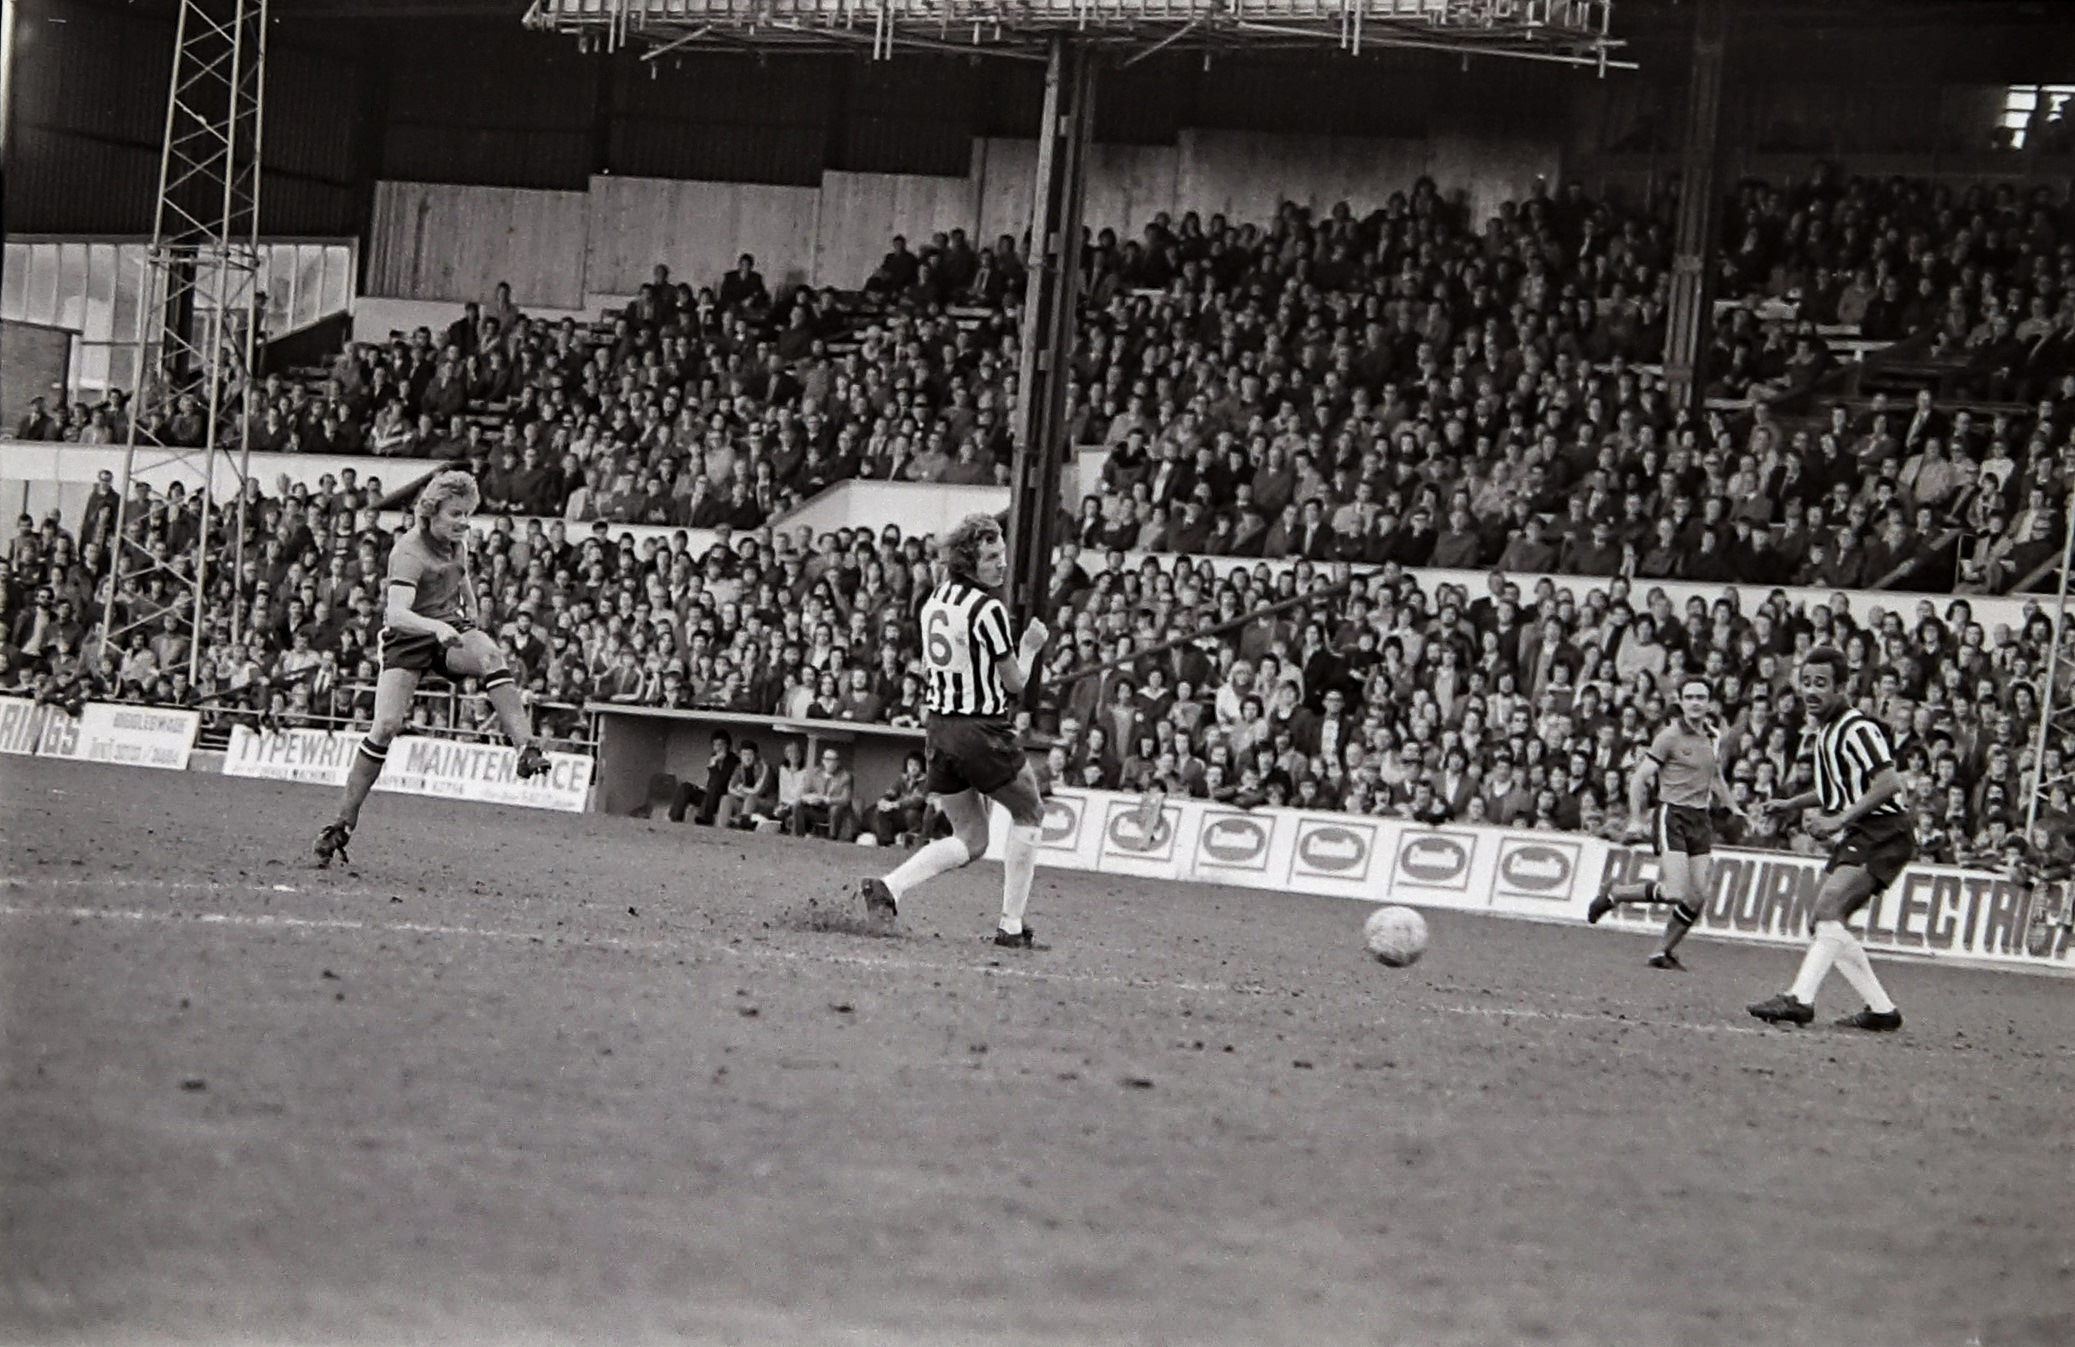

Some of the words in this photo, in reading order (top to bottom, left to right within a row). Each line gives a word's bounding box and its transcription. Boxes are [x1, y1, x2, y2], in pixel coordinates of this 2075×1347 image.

[927, 609, 951, 667] 6
[406, 742, 585, 793] MAINTENCE
[1597, 848, 1831, 938] REOURN
